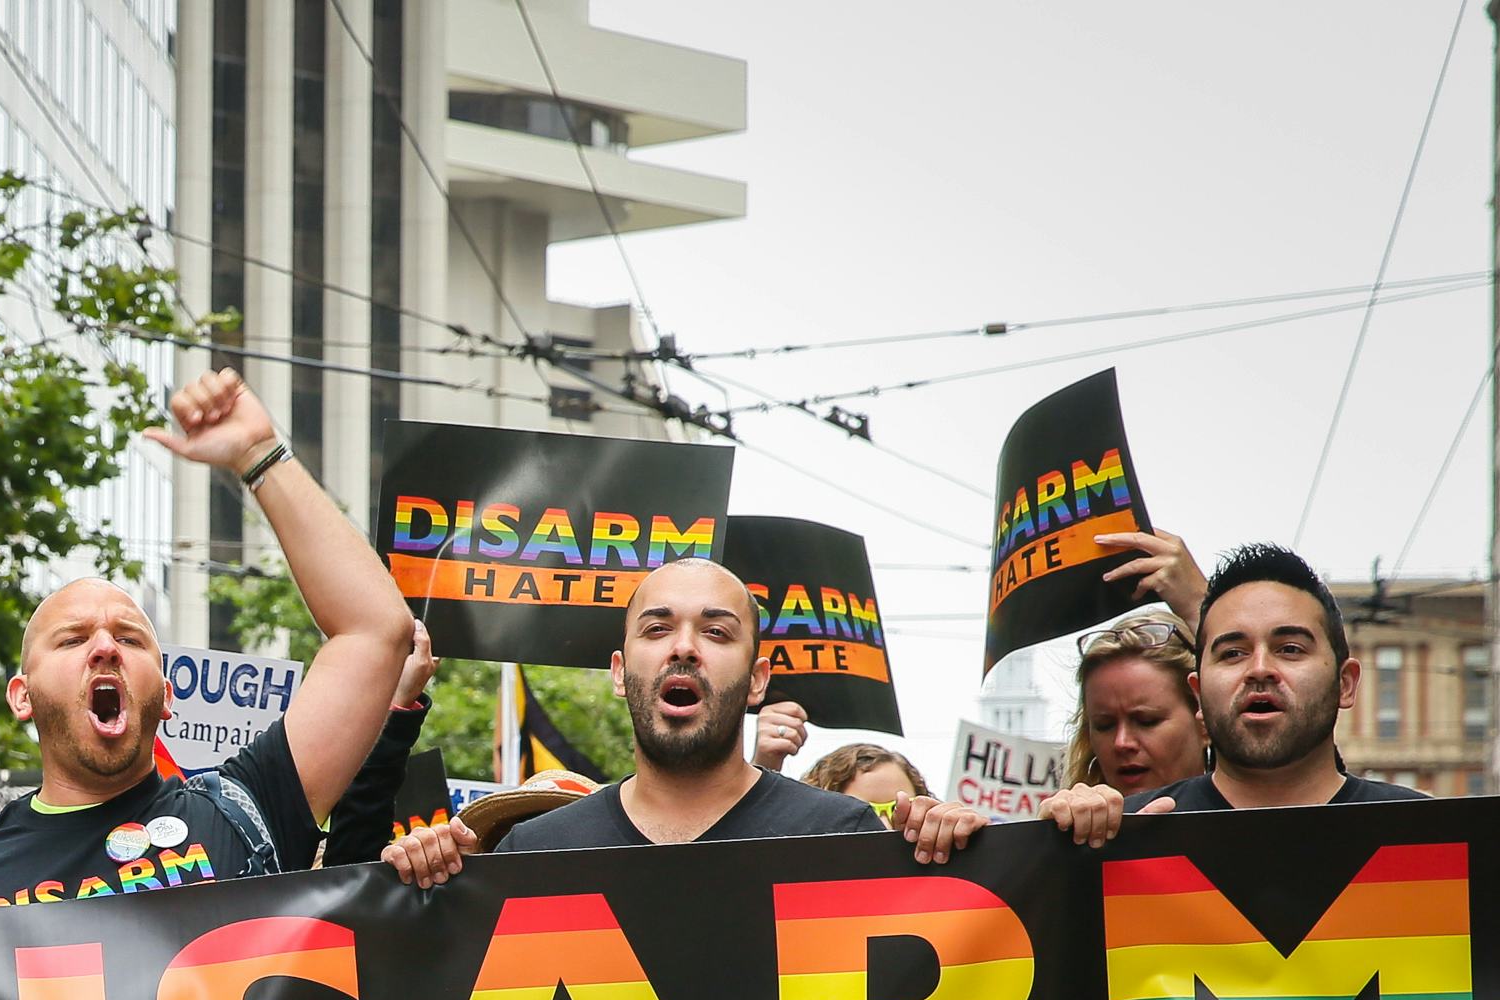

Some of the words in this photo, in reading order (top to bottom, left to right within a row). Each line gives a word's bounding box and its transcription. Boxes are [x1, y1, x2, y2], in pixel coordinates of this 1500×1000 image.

[393, 495, 715, 568] DISARM
[996, 448, 1132, 562] SARM
[464, 567, 616, 603] HATE
[995, 535, 1062, 602] HATE
[162, 653, 295, 712] OUGH
